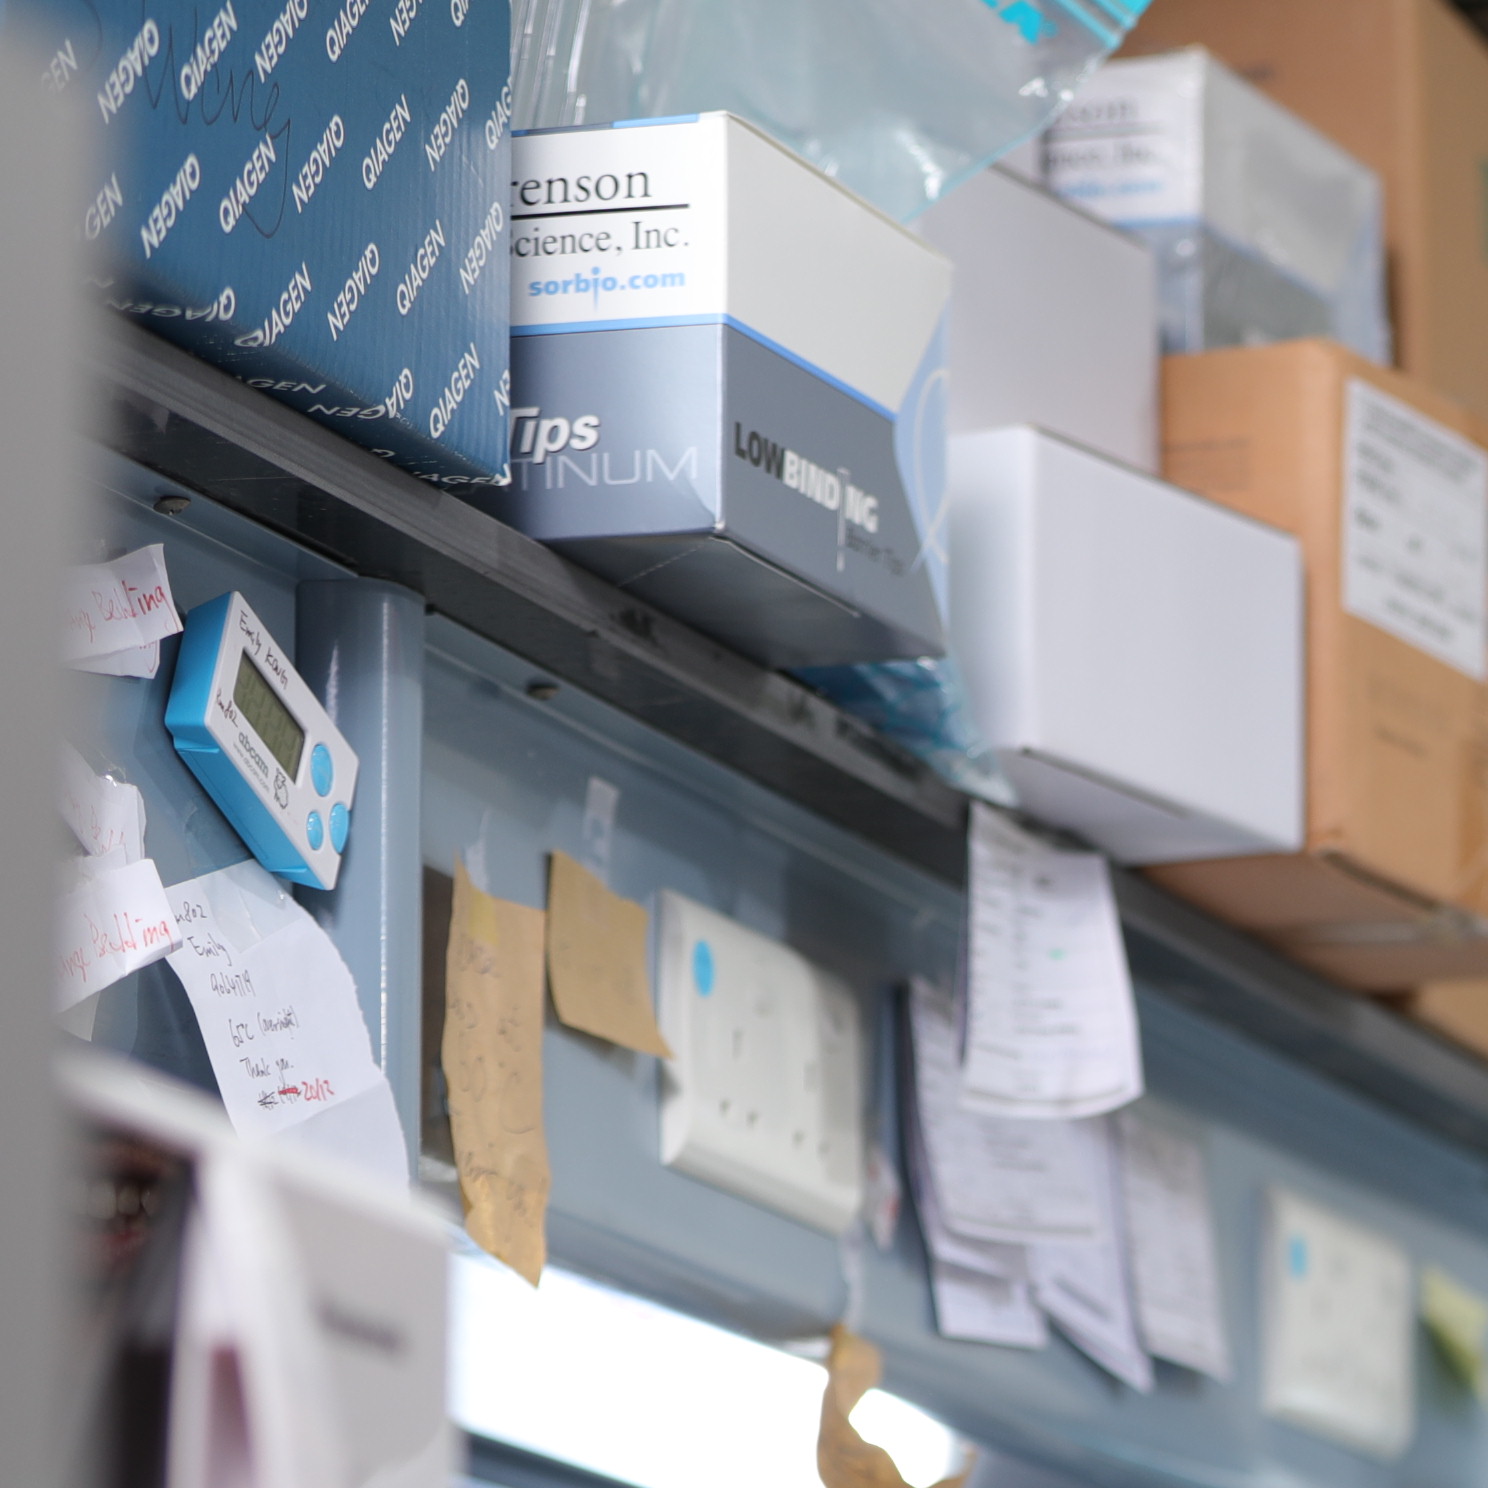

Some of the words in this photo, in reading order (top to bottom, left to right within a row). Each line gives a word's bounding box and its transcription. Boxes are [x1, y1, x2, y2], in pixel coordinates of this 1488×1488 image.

[97, 18, 160, 124] QIAGEN
[292, 114, 345, 214] QIAGEN
[362, 93, 412, 191] QIAGEN
[425, 78, 470, 172] QIAGEN
[141, 152, 201, 260] QIAGEN
[219, 132, 277, 234] QIAGEN
[396, 220, 446, 316] QIAGEN
[459, 202, 504, 295] QIAGEN
[510, 227, 623, 257] cience,
[631, 220, 690, 250] Inc.
[327, 242, 380, 342] QIAGEN
[429, 342, 481, 440] QIAGEN
[238, 732, 269, 779] abcam
